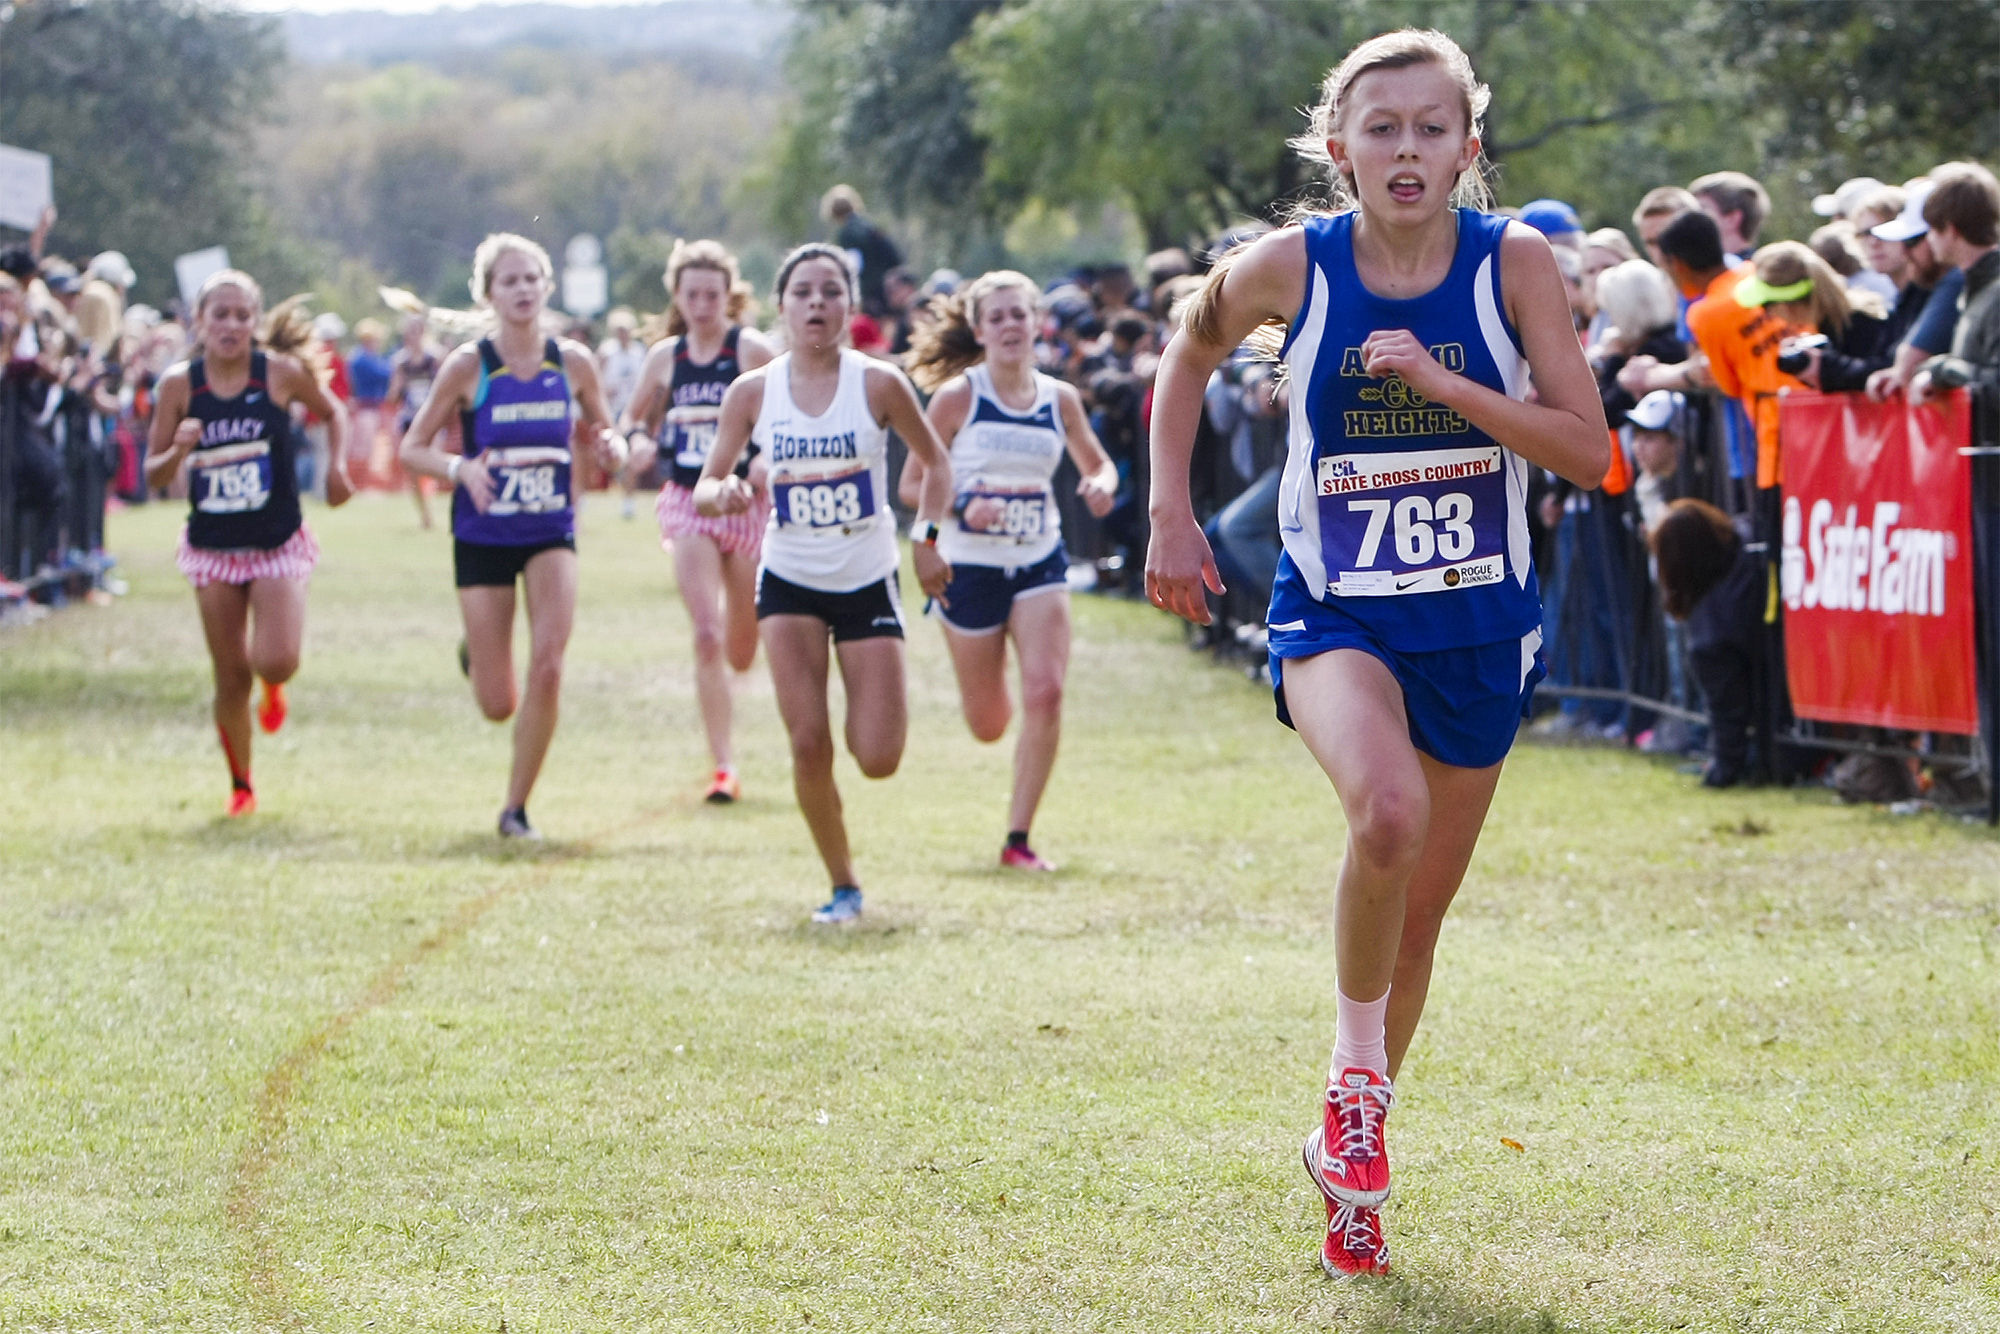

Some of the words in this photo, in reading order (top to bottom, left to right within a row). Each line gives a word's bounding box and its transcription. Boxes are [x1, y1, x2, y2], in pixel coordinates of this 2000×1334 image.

[200, 417, 266, 448] LEGACY
[1343, 409, 1470, 437] HEIGHTS
[773, 430, 857, 462] HORIZON
[1323, 474, 1368, 494] STATE
[1372, 465, 1420, 488] CROSS
[1425, 458, 1492, 481] COUNTRY
[788, 482, 861, 525] 693
[1347, 492, 1475, 569] 763
[1461, 565, 1493, 577] ROGUE
